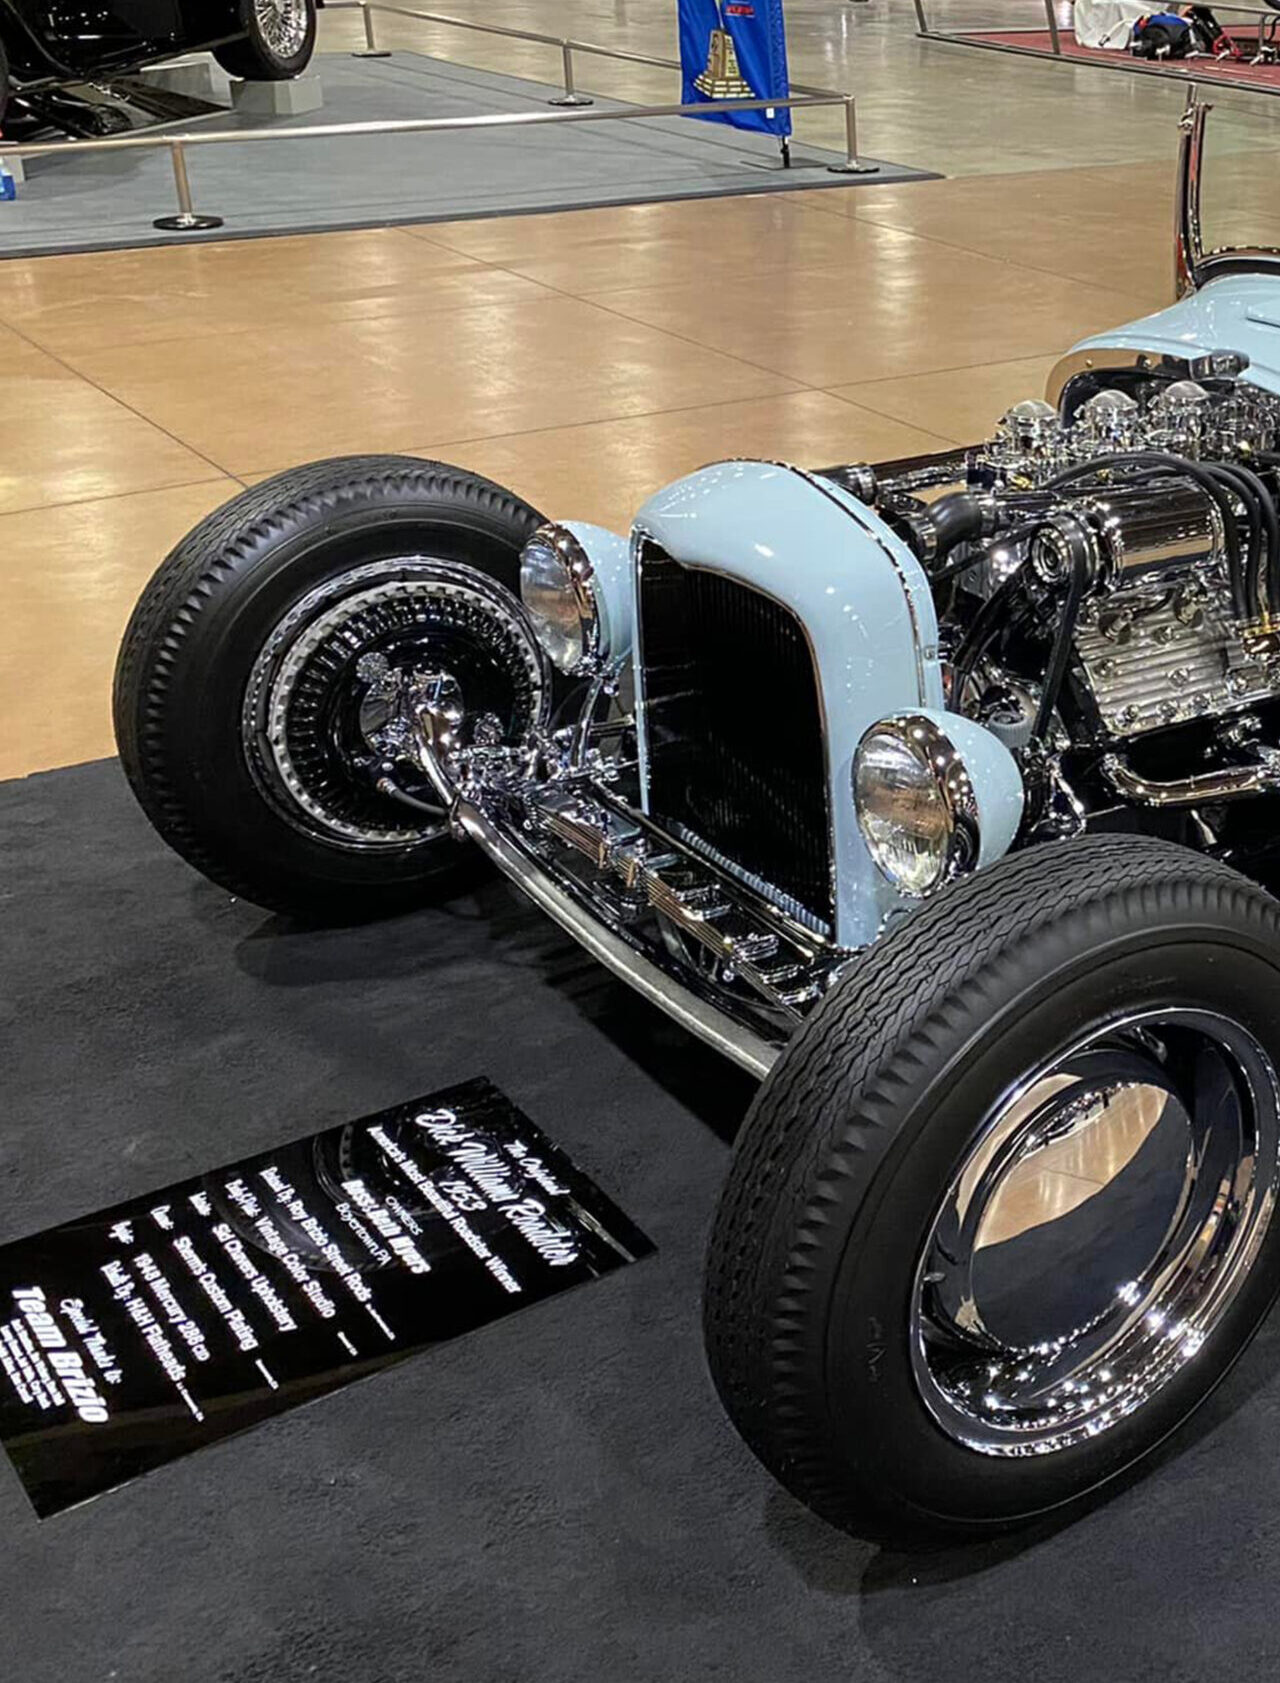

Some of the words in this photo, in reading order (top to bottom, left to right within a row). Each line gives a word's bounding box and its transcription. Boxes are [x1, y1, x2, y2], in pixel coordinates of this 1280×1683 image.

[399, 1160, 427, 1184] Most
[450, 1217, 491, 1258] Roadster
[486, 1256, 521, 1292] Winner
[415, 1109, 475, 1145] Dick
[447, 1142, 522, 1202] Williams
[498, 1198, 578, 1265] Roadster
[439, 1181, 487, 1211] 1953
[134, 1253, 161, 1281] 1948
[150, 1277, 187, 1323] Mercury
[212, 1223, 235, 1242] Sid
[251, 1276, 297, 1331] Upholstery
[255, 1216, 295, 1258] Vintage
[279, 1253, 310, 1282] Color
[302, 1280, 335, 1318] Studio
[287, 1200, 308, 1220] Roy
[301, 1217, 328, 1246] Brizio
[321, 1243, 354, 1276] Street
[344, 1272, 371, 1301] Rods
[388, 1236, 431, 1273] Myers
[12, 1287, 66, 1347] Team
[47, 1352, 108, 1422] Brizio
[126, 1298, 155, 1326] H&H
[142, 1323, 185, 1381] Flatheads
[199, 1273, 232, 1313] Custom
[224, 1309, 258, 1351] Plating
